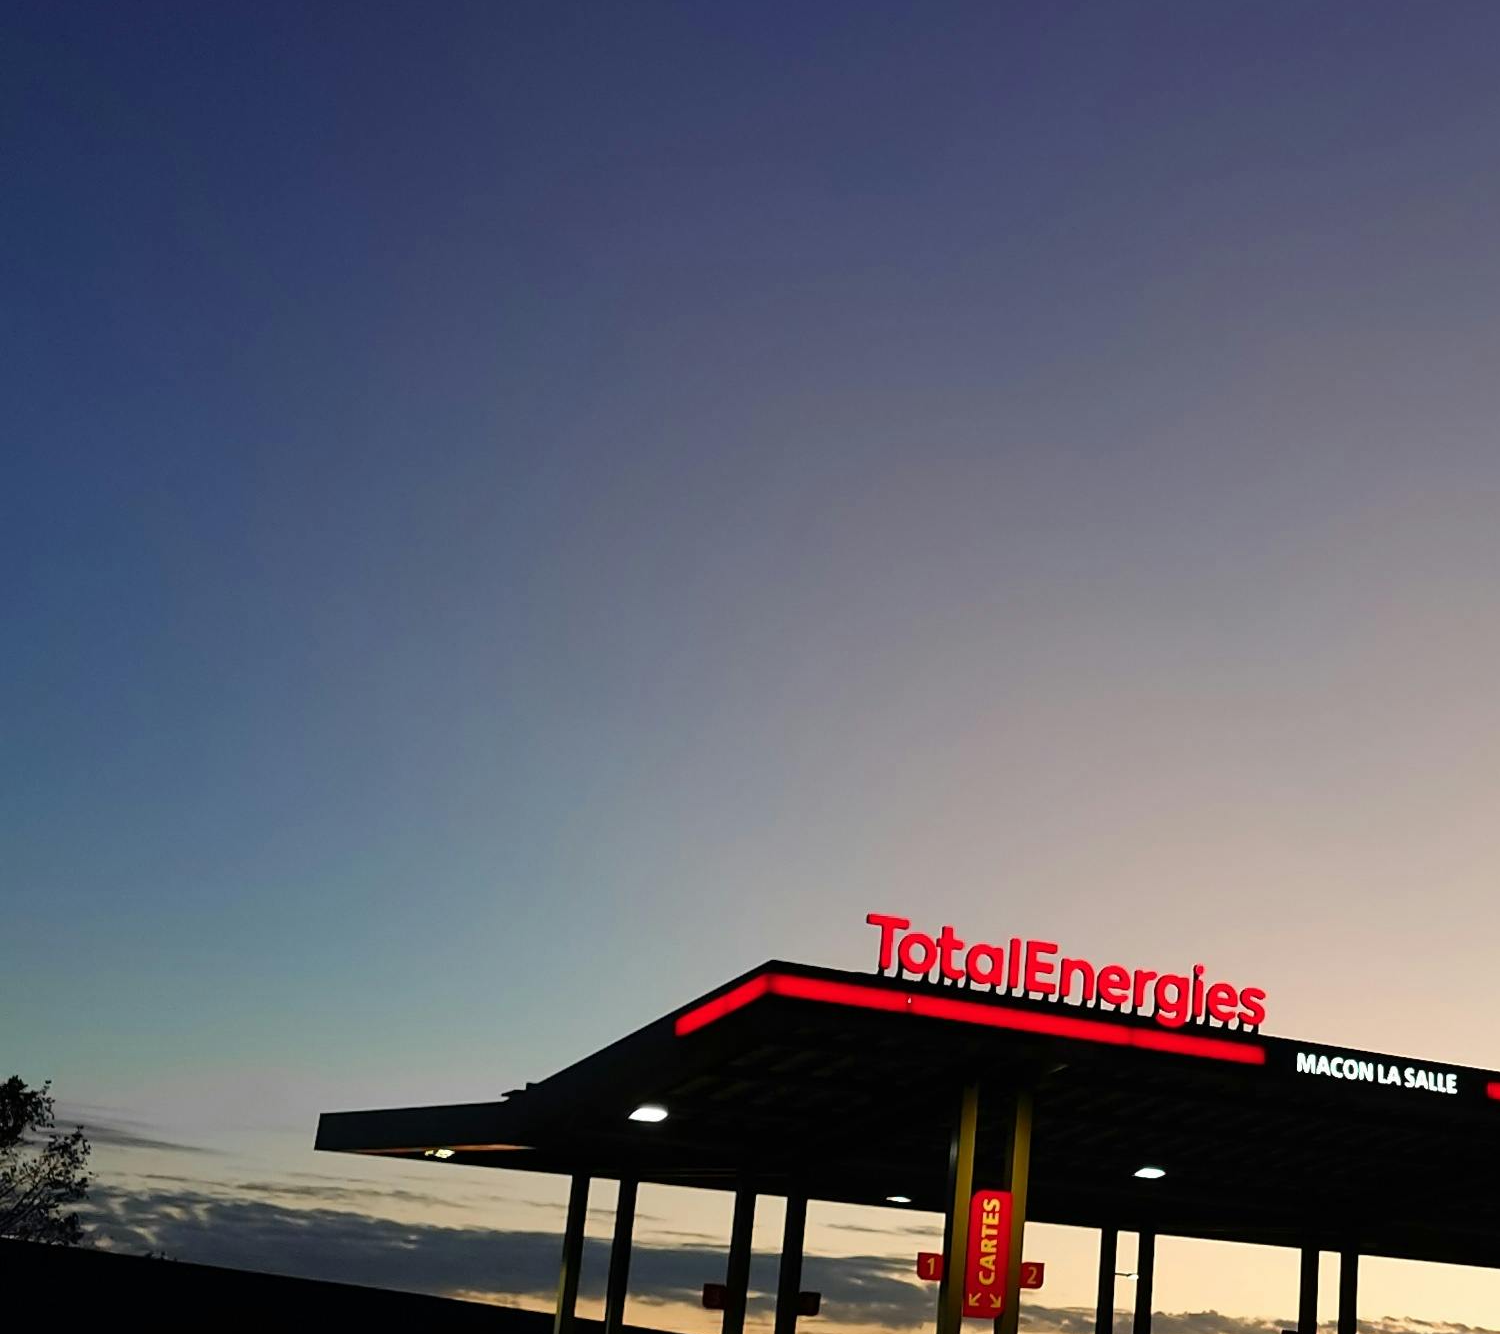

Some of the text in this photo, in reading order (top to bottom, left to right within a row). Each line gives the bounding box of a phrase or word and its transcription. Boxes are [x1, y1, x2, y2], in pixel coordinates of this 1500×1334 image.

[866, 913, 1266, 1028] TotalEnergies
[1296, 1052, 1458, 1095] MACON LA SALLE
[979, 1198, 1001, 1286] CARTES
[927, 1257, 935, 1276] 1
[1026, 1267, 1038, 1285] 2
